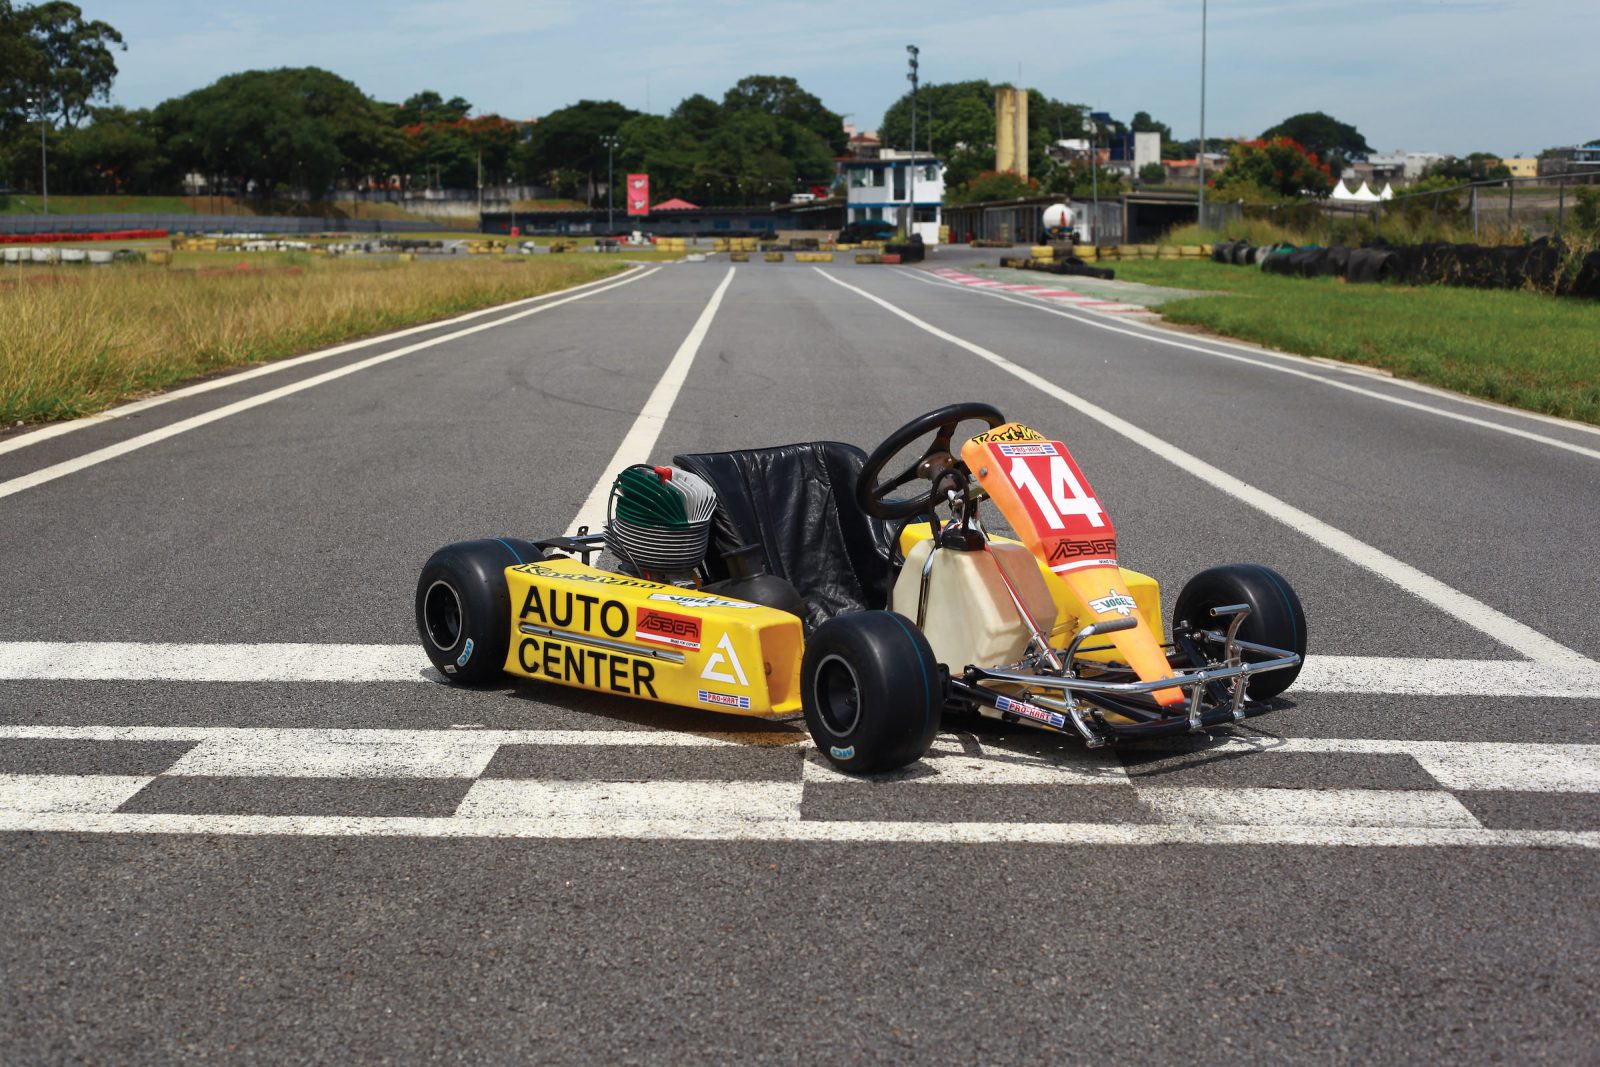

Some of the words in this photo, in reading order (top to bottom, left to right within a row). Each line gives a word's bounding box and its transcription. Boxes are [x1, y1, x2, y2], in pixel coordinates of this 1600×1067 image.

[1009, 456, 1105, 530] 14
[519, 585, 629, 638] AUTO
[1099, 597, 1132, 608] VOGEL
[518, 636, 659, 699] CENTER
[707, 693, 738, 705] PRO-KART
[1009, 702, 1051, 721] PRO-KART
